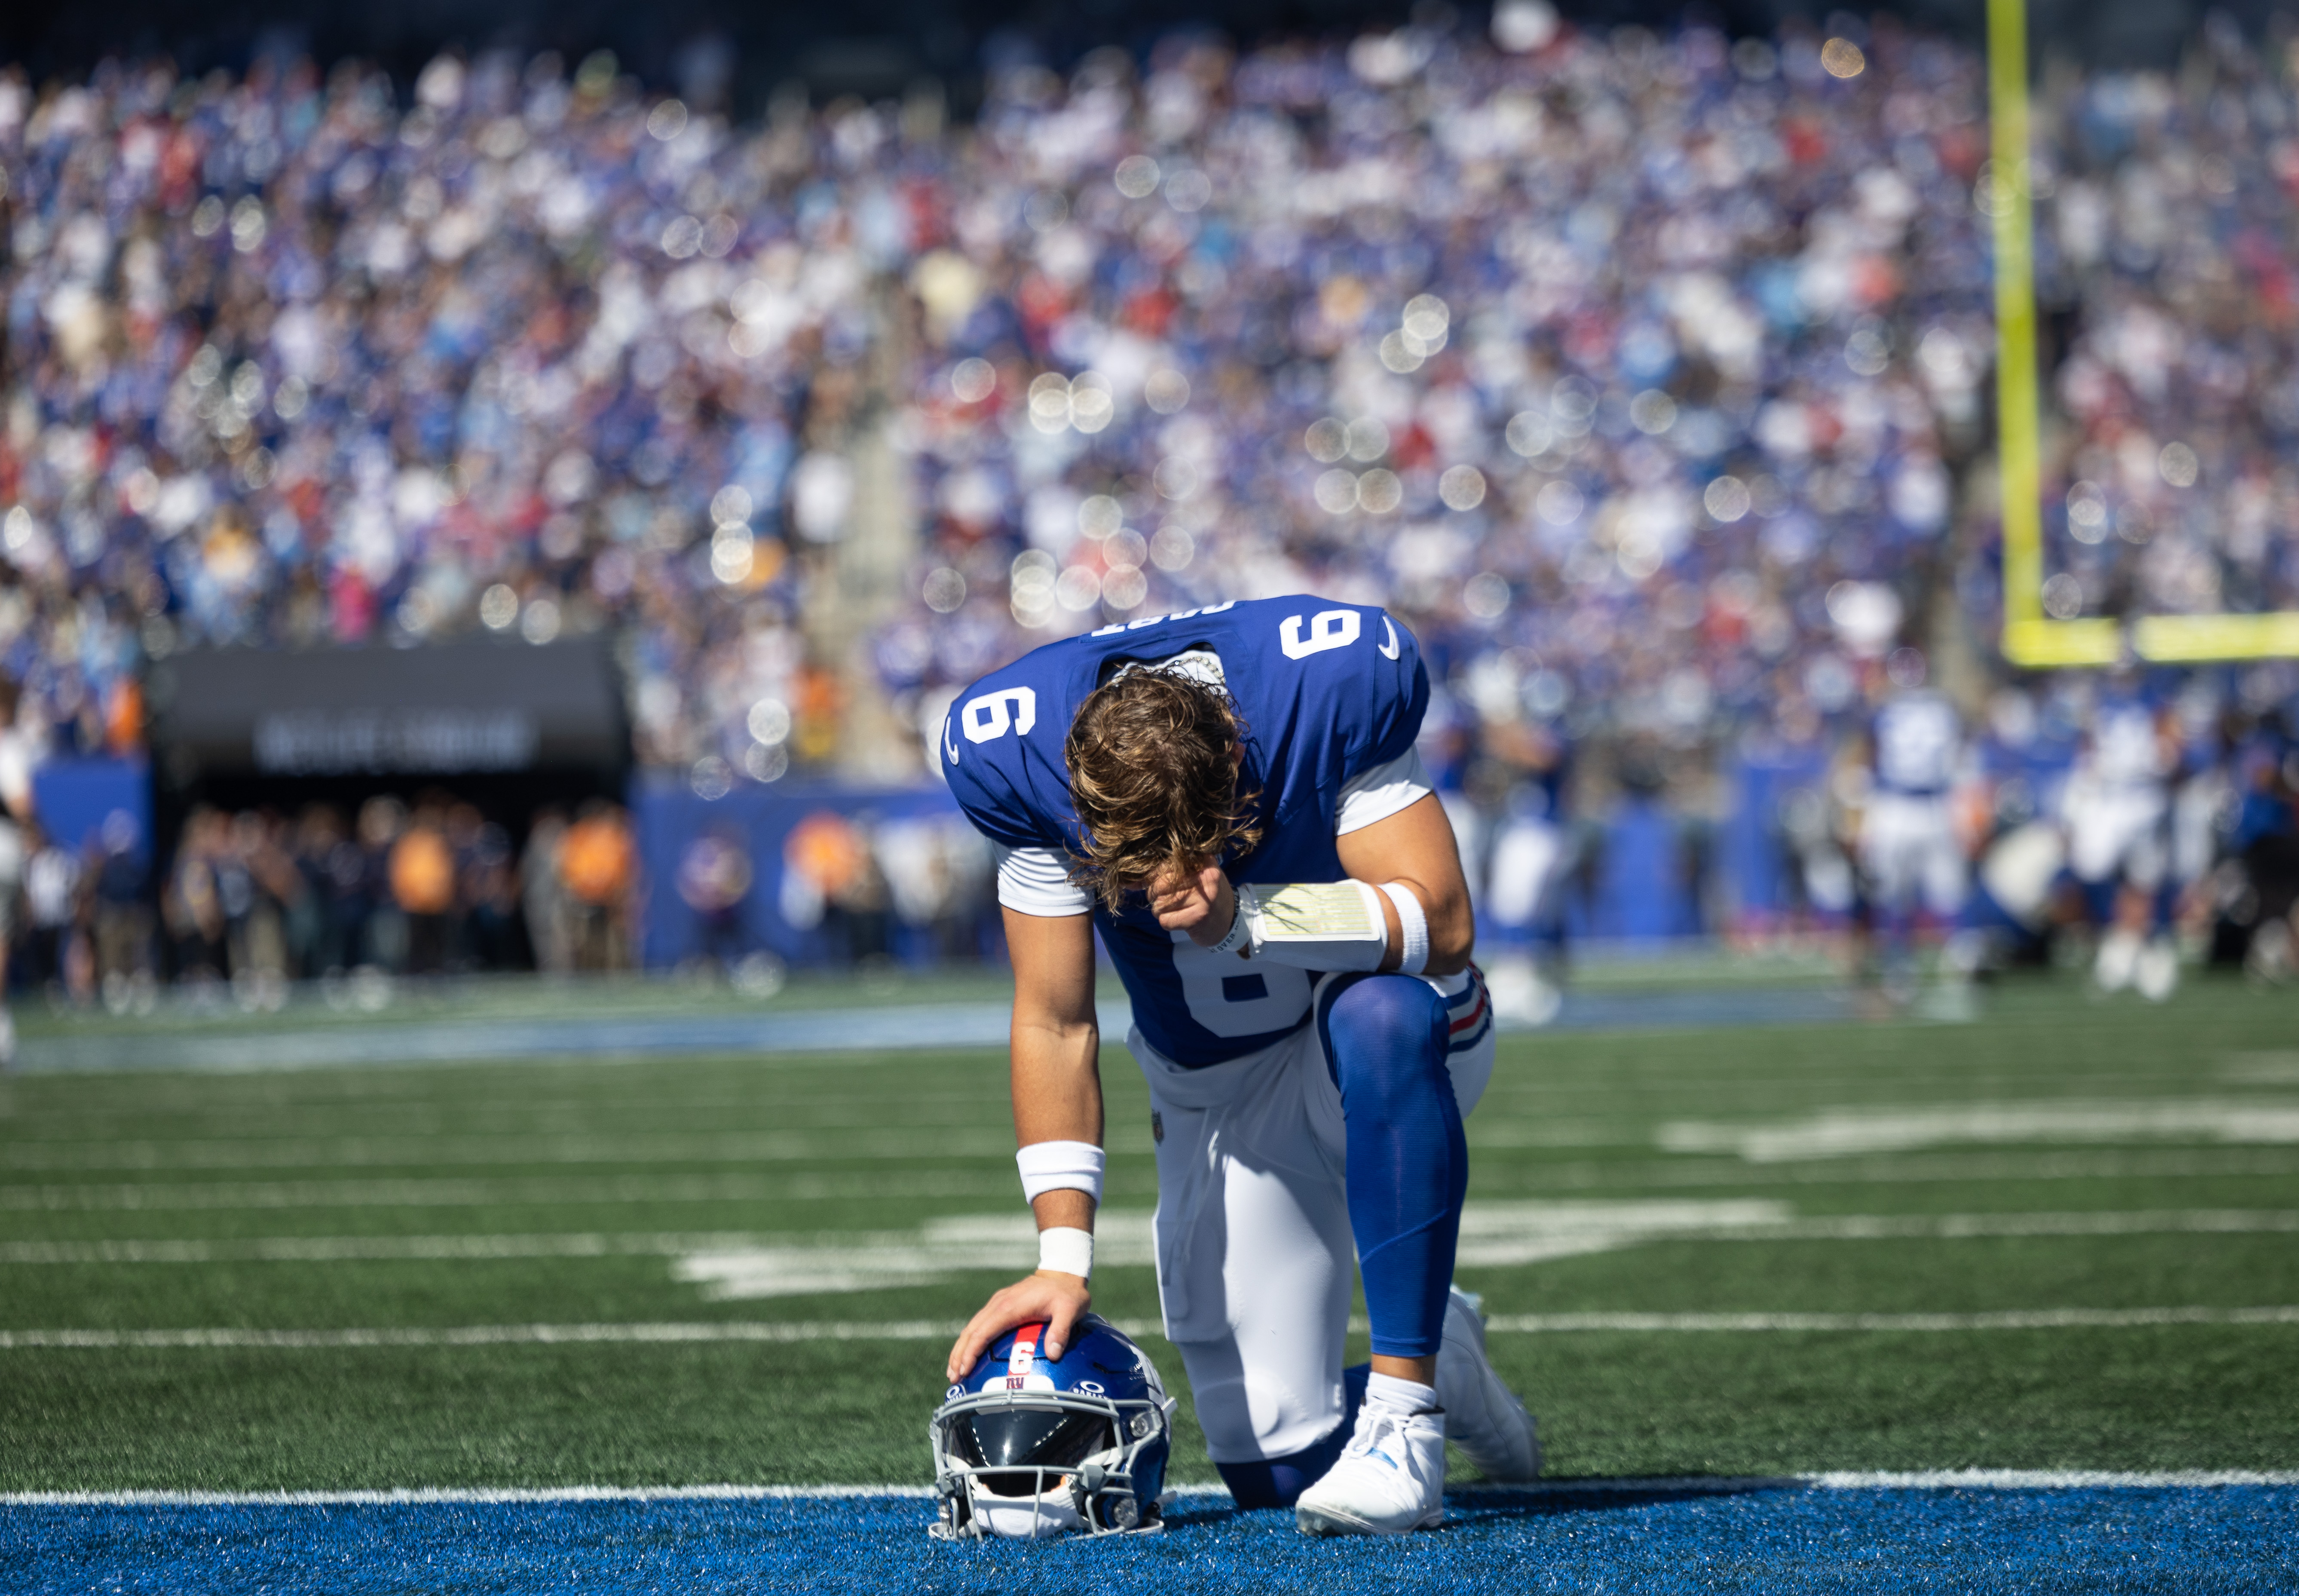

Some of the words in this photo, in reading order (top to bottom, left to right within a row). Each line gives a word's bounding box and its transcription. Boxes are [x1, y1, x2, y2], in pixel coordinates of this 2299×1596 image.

[1277, 609, 1361, 660] 6
[961, 686, 1036, 744] 6
[1217, 933, 1235, 951] OVER
[1009, 1341, 1035, 1375] 6
